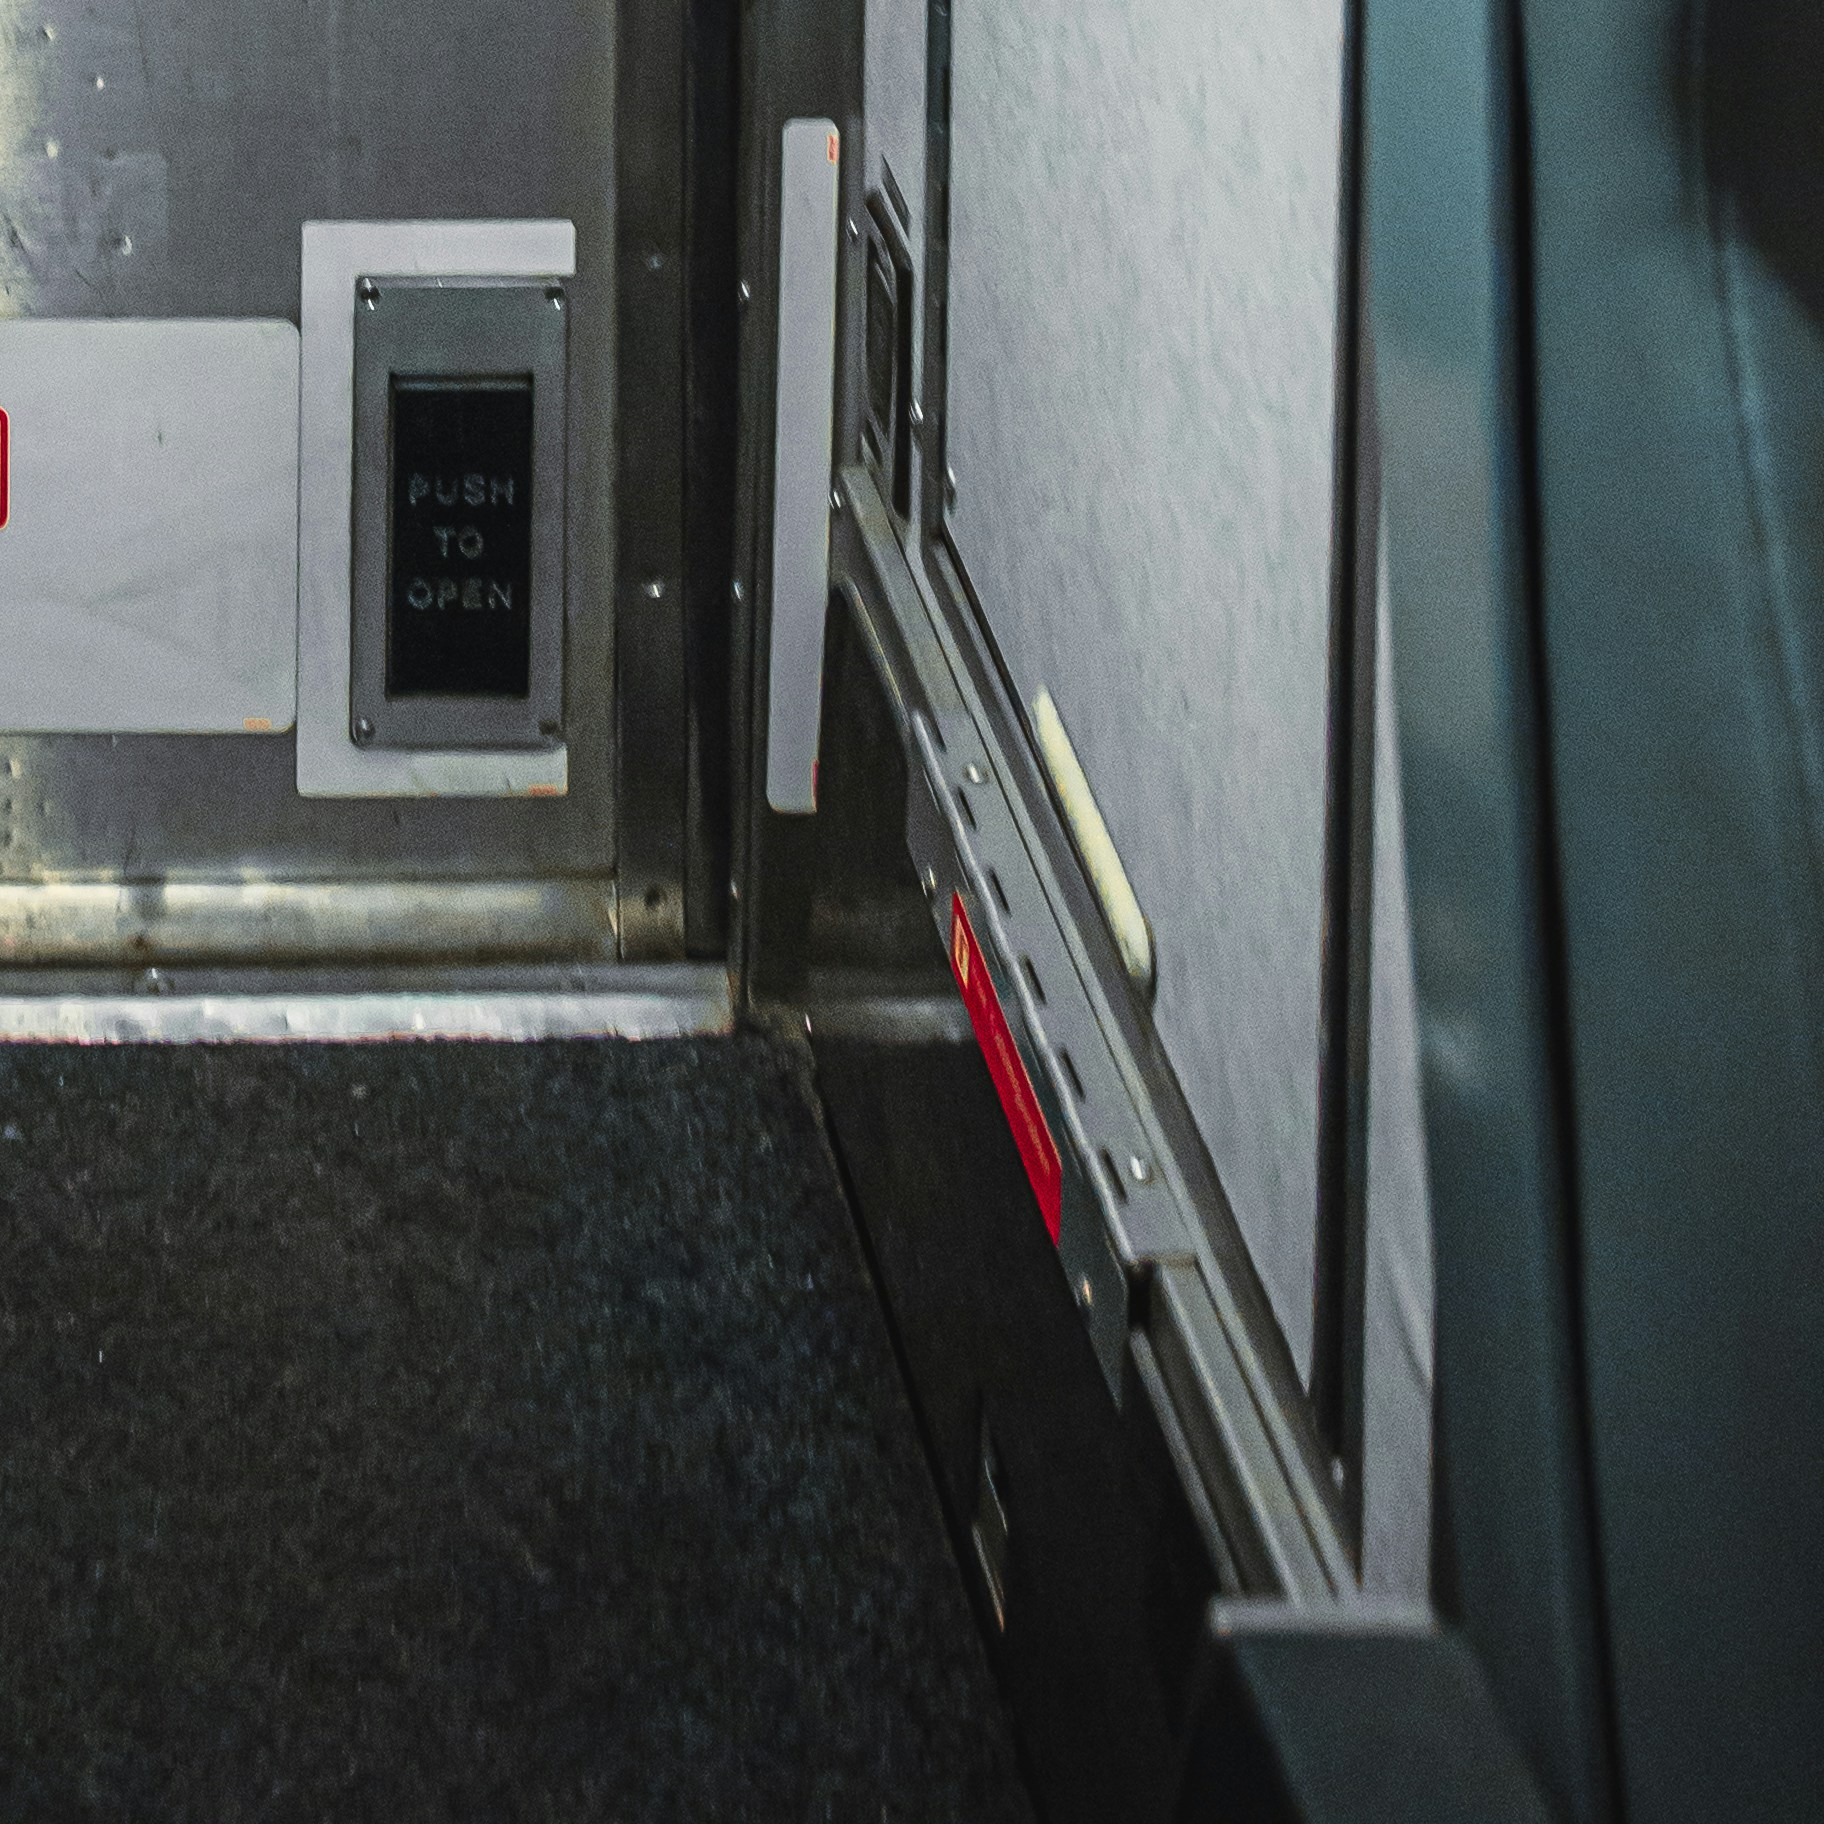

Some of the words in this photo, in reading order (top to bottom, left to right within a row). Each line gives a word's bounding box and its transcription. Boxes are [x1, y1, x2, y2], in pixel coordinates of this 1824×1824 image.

[407, 472, 516, 508] PUSH
[432, 525, 485, 560] TO
[406, 577, 514, 612] OPEN
